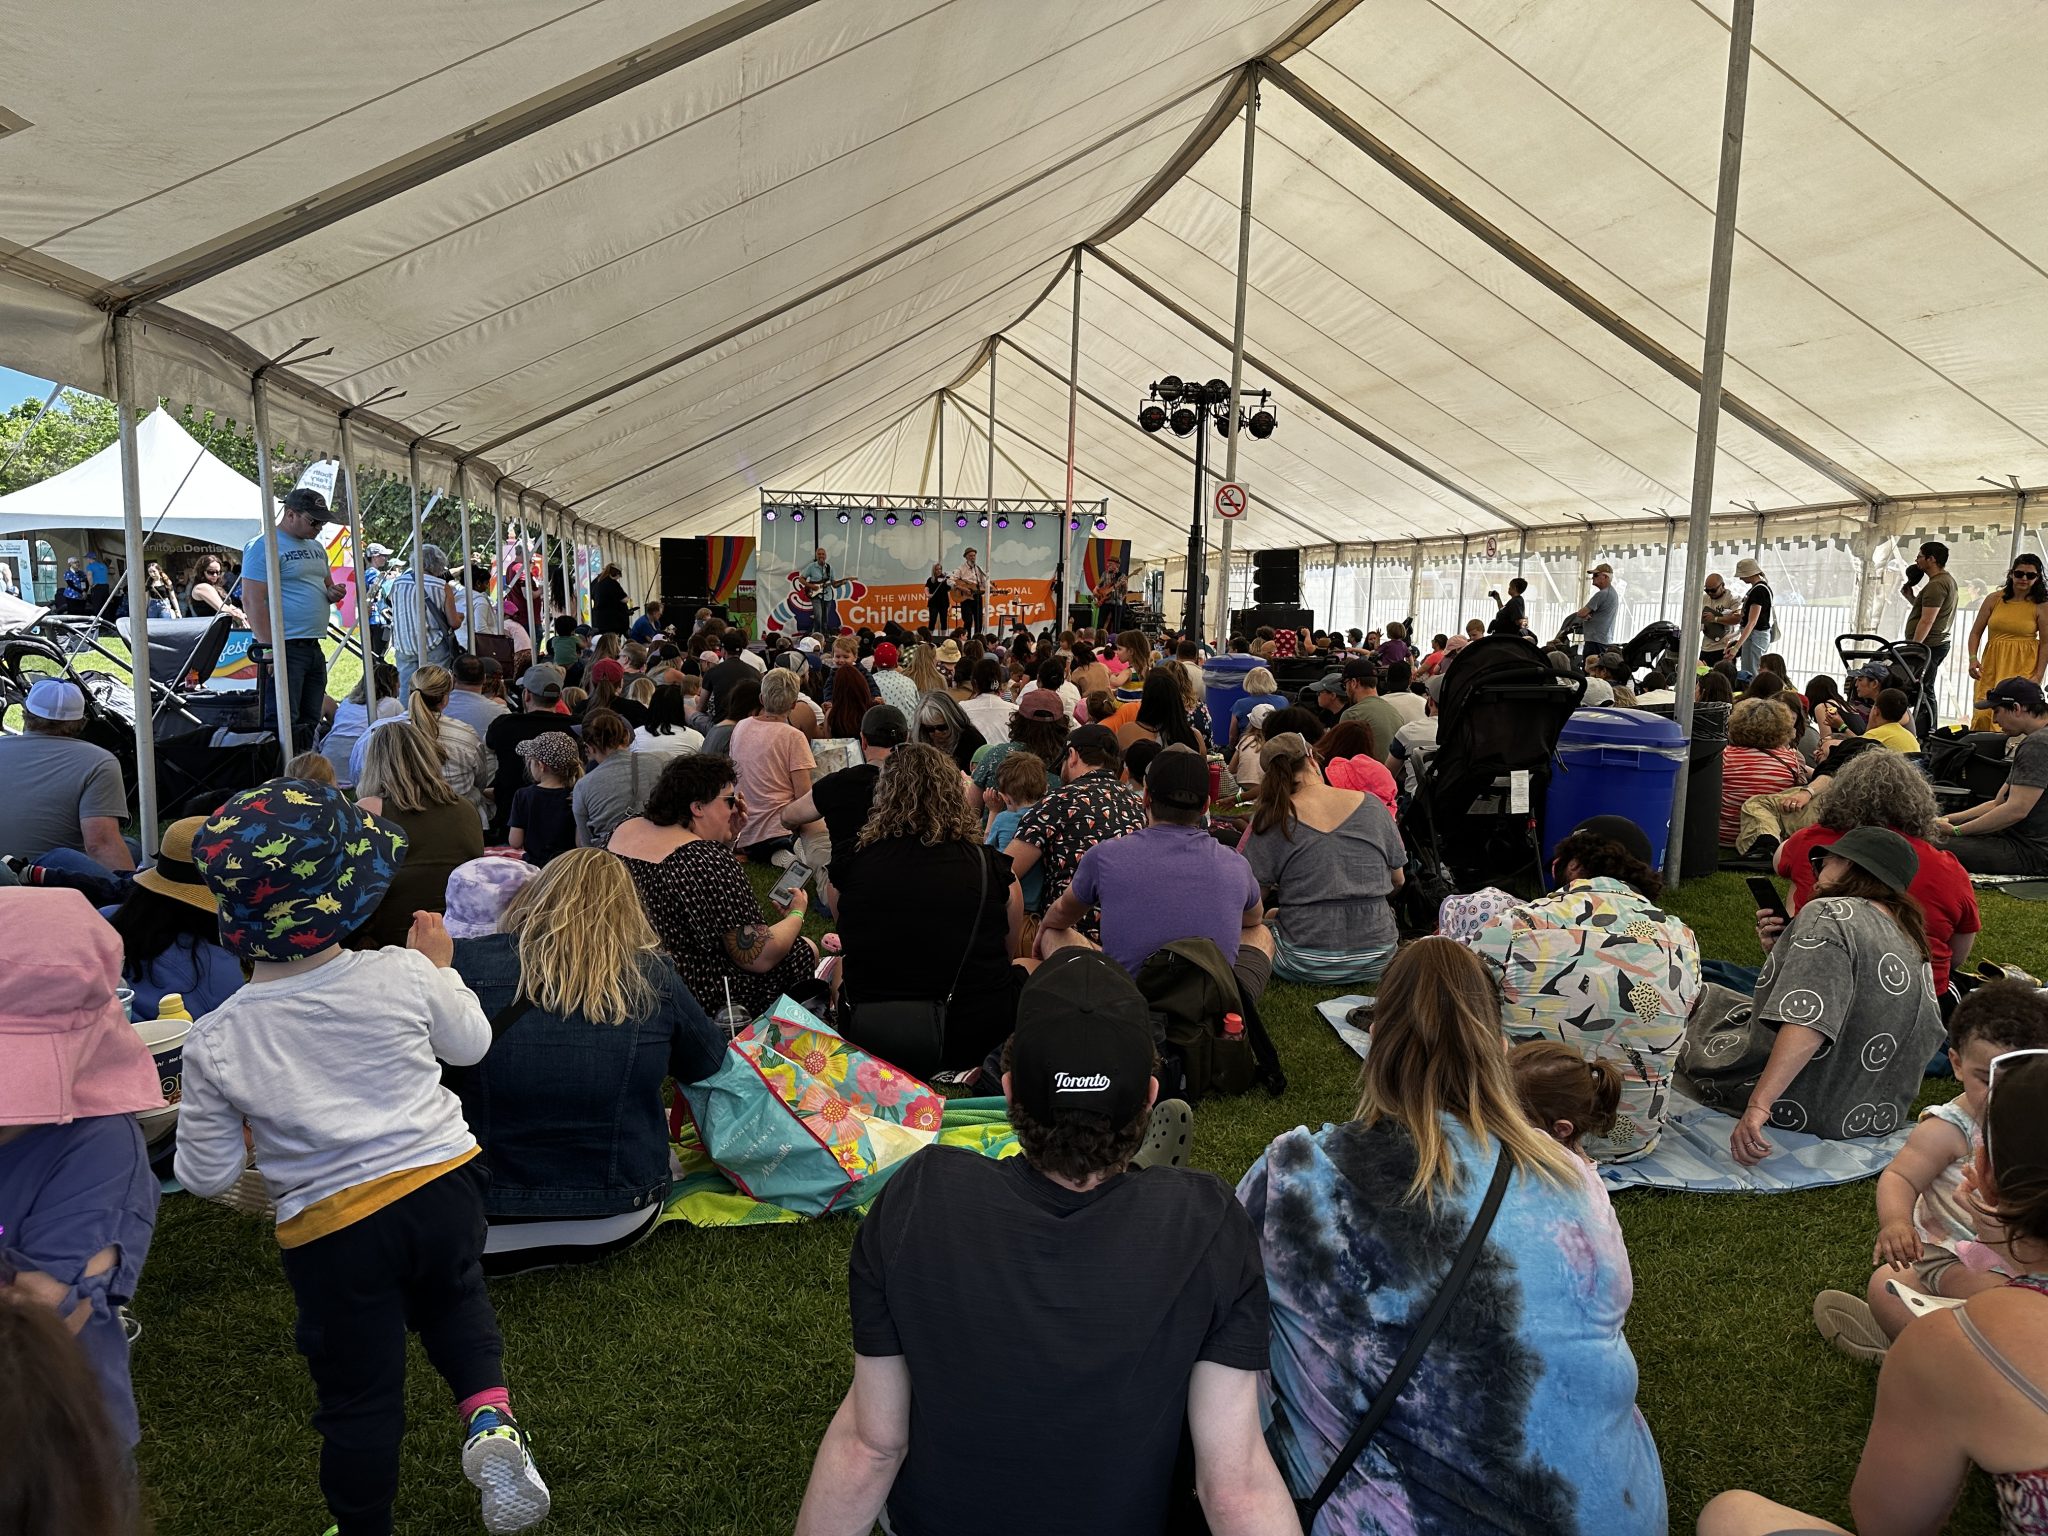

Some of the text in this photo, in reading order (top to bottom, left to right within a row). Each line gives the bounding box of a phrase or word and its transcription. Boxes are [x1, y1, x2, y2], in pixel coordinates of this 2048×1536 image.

[874, 586, 1032, 603] THE WINN ONAL
[1054, 1072, 1111, 1094] Toronto
[761, 1142, 793, 1181] Marshalls
